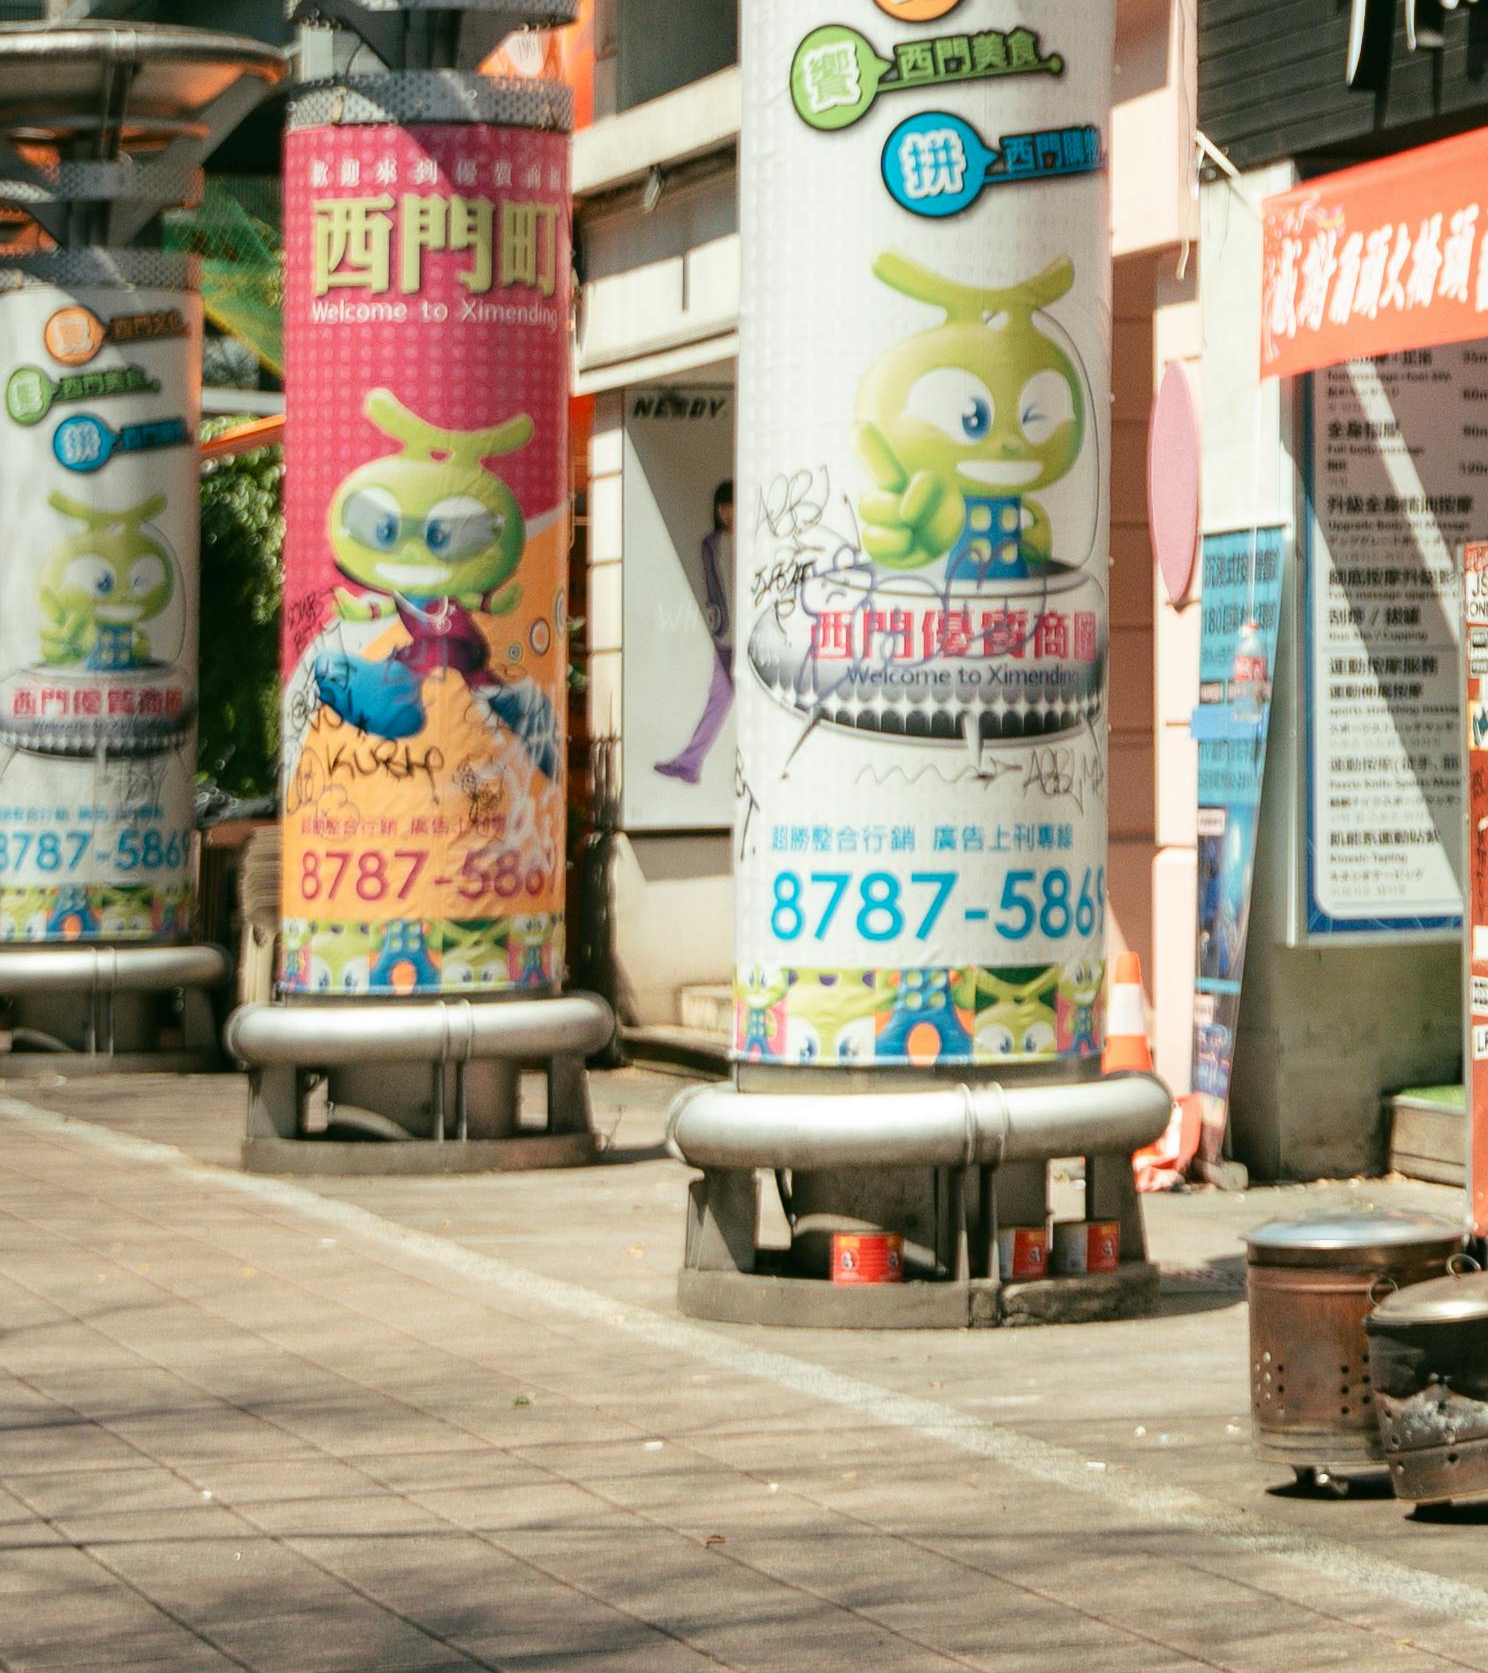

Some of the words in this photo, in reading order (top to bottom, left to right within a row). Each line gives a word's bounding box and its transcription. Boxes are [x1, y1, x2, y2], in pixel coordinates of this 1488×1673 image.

[894, 27, 1040, 81] 西門美食
[902, 129, 966, 198] 拼
[311, 192, 561, 298] 西門町
[311, 300, 408, 324] Welcome
[421, 300, 449, 323] to
[456, 300, 559, 330] Ximending
[809, 608, 1097, 664] 西門優質商圈
[845, 664, 953, 688] Welcome
[958, 665, 983, 686] to
[987, 665, 1082, 691] Ximending
[0, 827, 192, 874] 787-586
[771, 824, 917, 853] 超勝整合行銷
